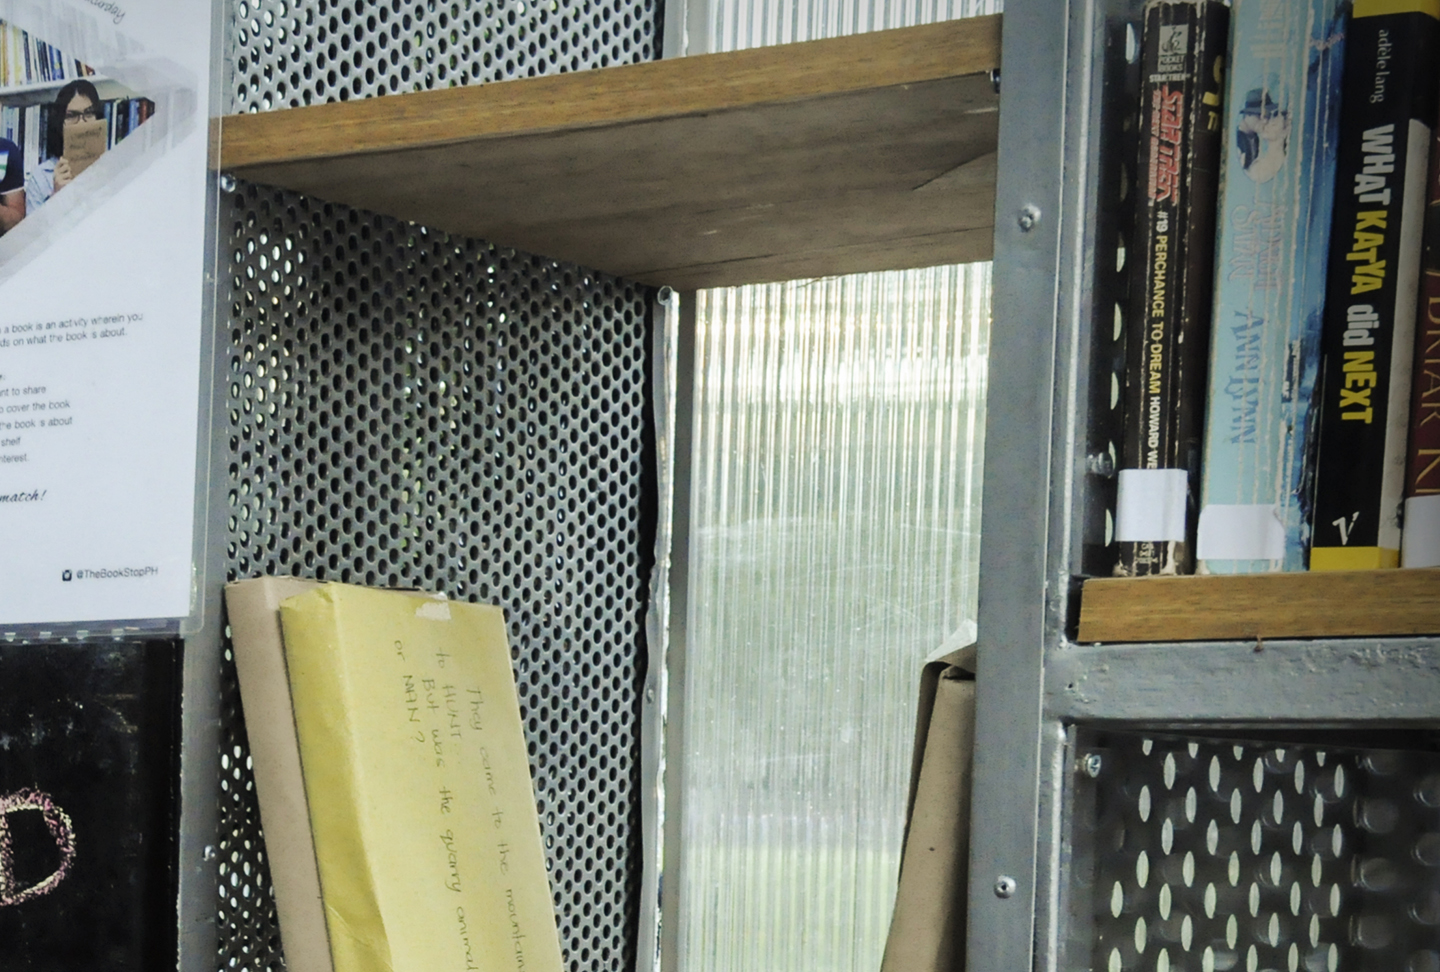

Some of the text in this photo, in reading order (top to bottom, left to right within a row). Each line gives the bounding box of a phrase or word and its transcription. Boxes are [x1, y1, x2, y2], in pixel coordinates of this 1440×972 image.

[1369, 29, 1393, 104] adèle lang
[1157, 84, 1185, 206] STAR TREK
[1339, 123, 1396, 424] WHAT KATYA did NEXT
[11, 322, 34, 334] book
[35, 322, 44, 332] is
[45, 321, 57, 331] an
[58, 317, 89, 329] activity
[90, 314, 126, 326] wherein
[127, 312, 144, 323] you
[12, 337, 25, 348] on
[26, 334, 47, 346] what
[49, 332, 64, 343] the
[65, 330, 88, 342] book
[99, 327, 129, 339] about.
[1147, 210, 1169, 450] #19 PERCHANCE TO DREAM HOWARD
[11, 386, 21, 397] to
[22, 384, 48, 396] share
[1223, 310, 1265, 445] ANN LYNN
[6, 403, 31, 414] cover
[32, 401, 47, 412] the
[48, 399, 72, 411] book
[14, 418, 37, 430] book
[47, 415, 74, 428] about
[0, 435, 22, 448] shelf
[76, 566, 159, 580] @TheBookStopPH
[394, 639, 406, 662] or
[435, 647, 451, 669] to
[421, 678, 440, 714] But
[465, 685, 485, 731] They
[431, 728, 446, 769] was
[479, 746, 497, 797] came
[438, 785, 453, 815] the
[491, 806, 504, 830] to
[439, 828, 462, 894] quarry
[497, 842, 510, 876] the
